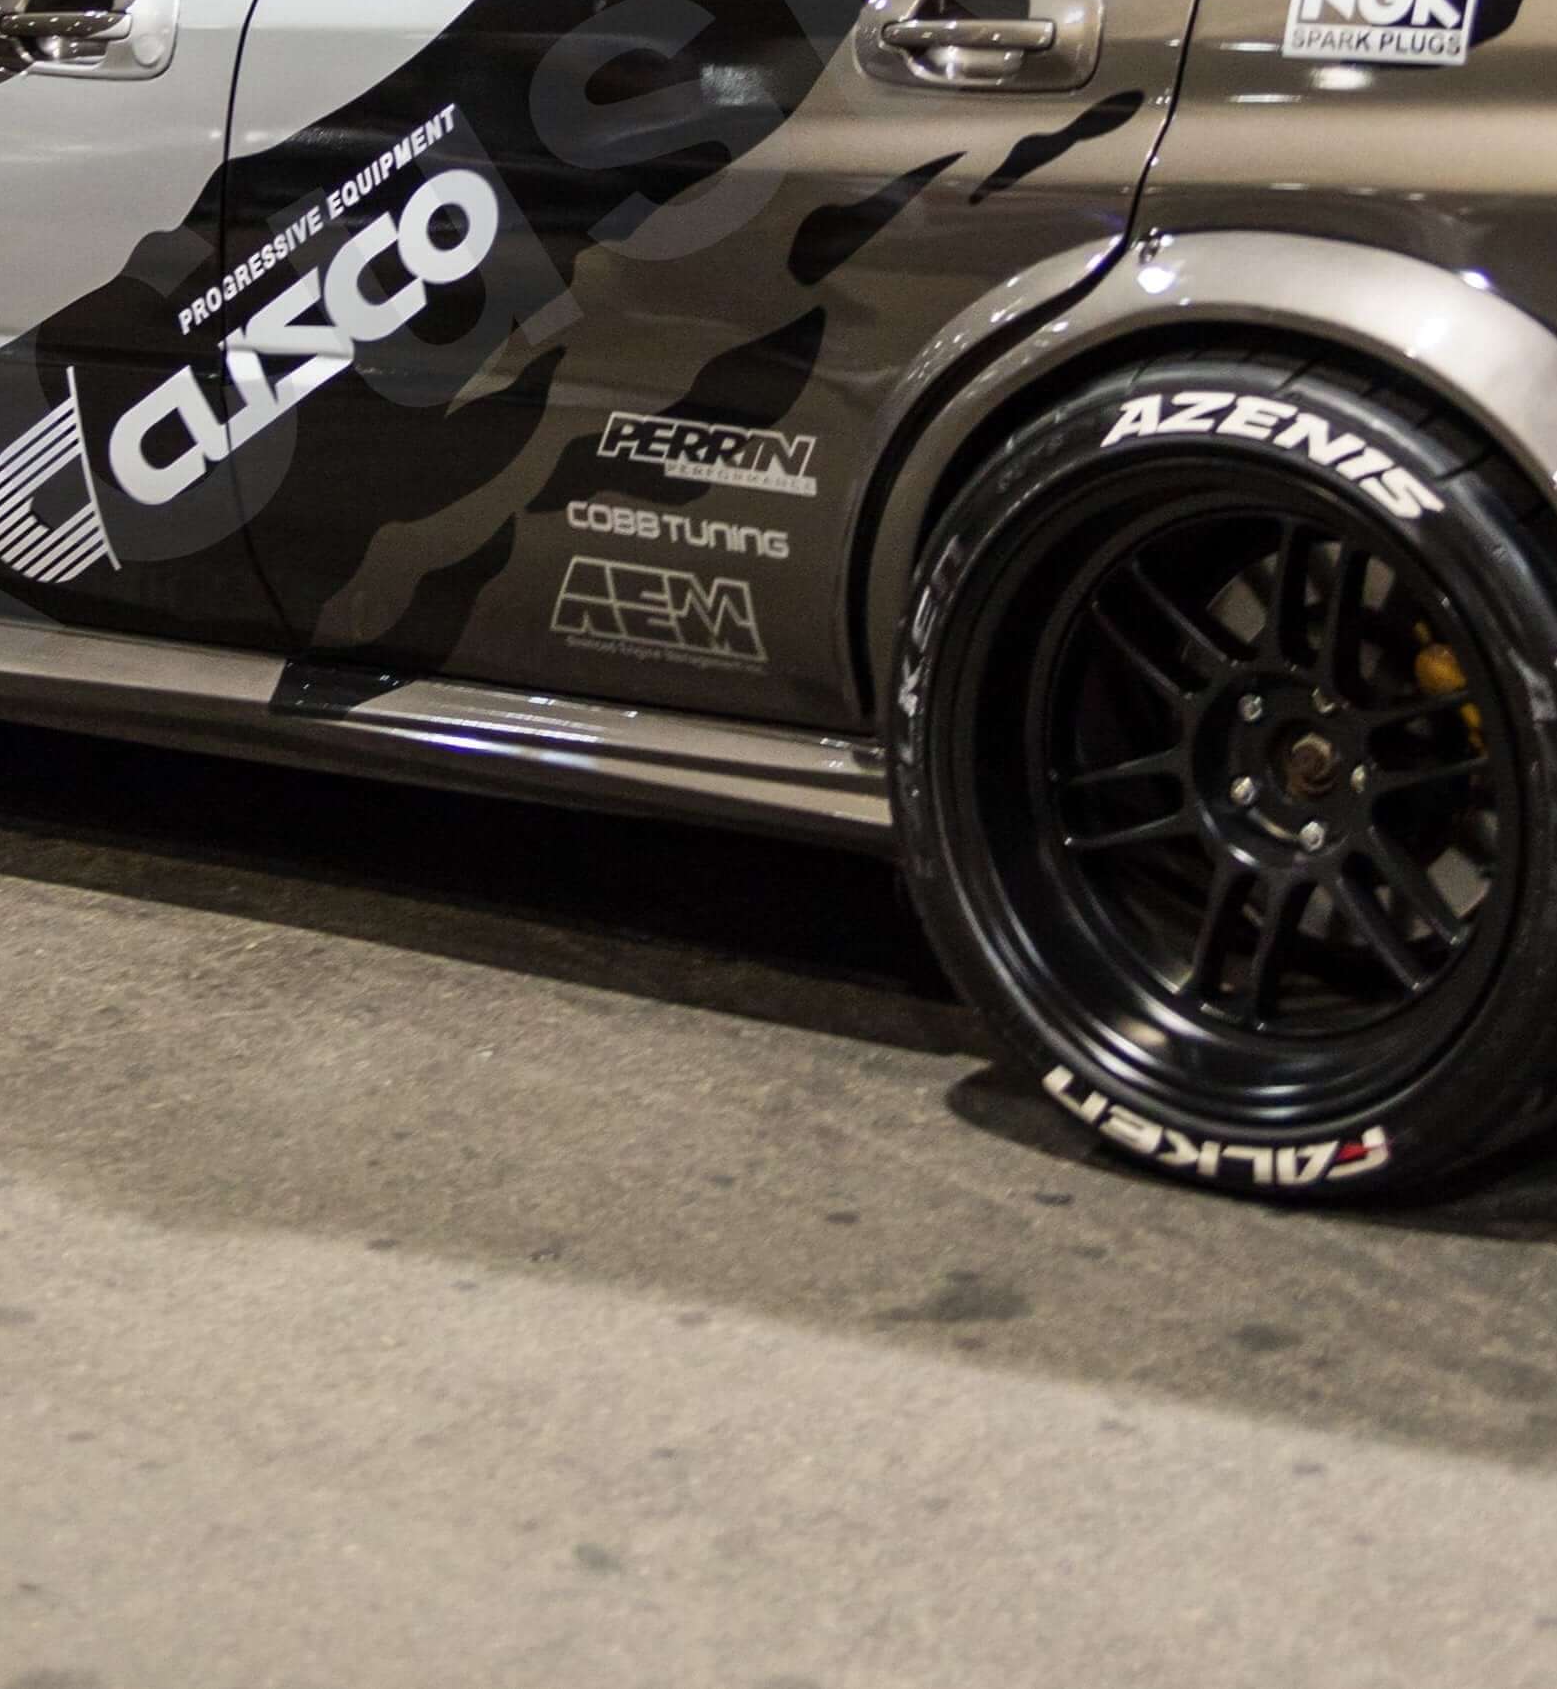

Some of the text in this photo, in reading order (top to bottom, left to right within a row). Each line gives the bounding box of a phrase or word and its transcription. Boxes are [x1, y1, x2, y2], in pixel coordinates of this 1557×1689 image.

[1292, 29, 1462, 56] SPARK PLUGS
[177, 103, 456, 335] PROGRESSIVE EQUIPMENT
[596, 411, 817, 479] PERRIN
[1099, 391, 1445, 519] AZENIS
[549, 555, 769, 662] AEM
[1042, 1064, 1390, 1185] FALKEN
